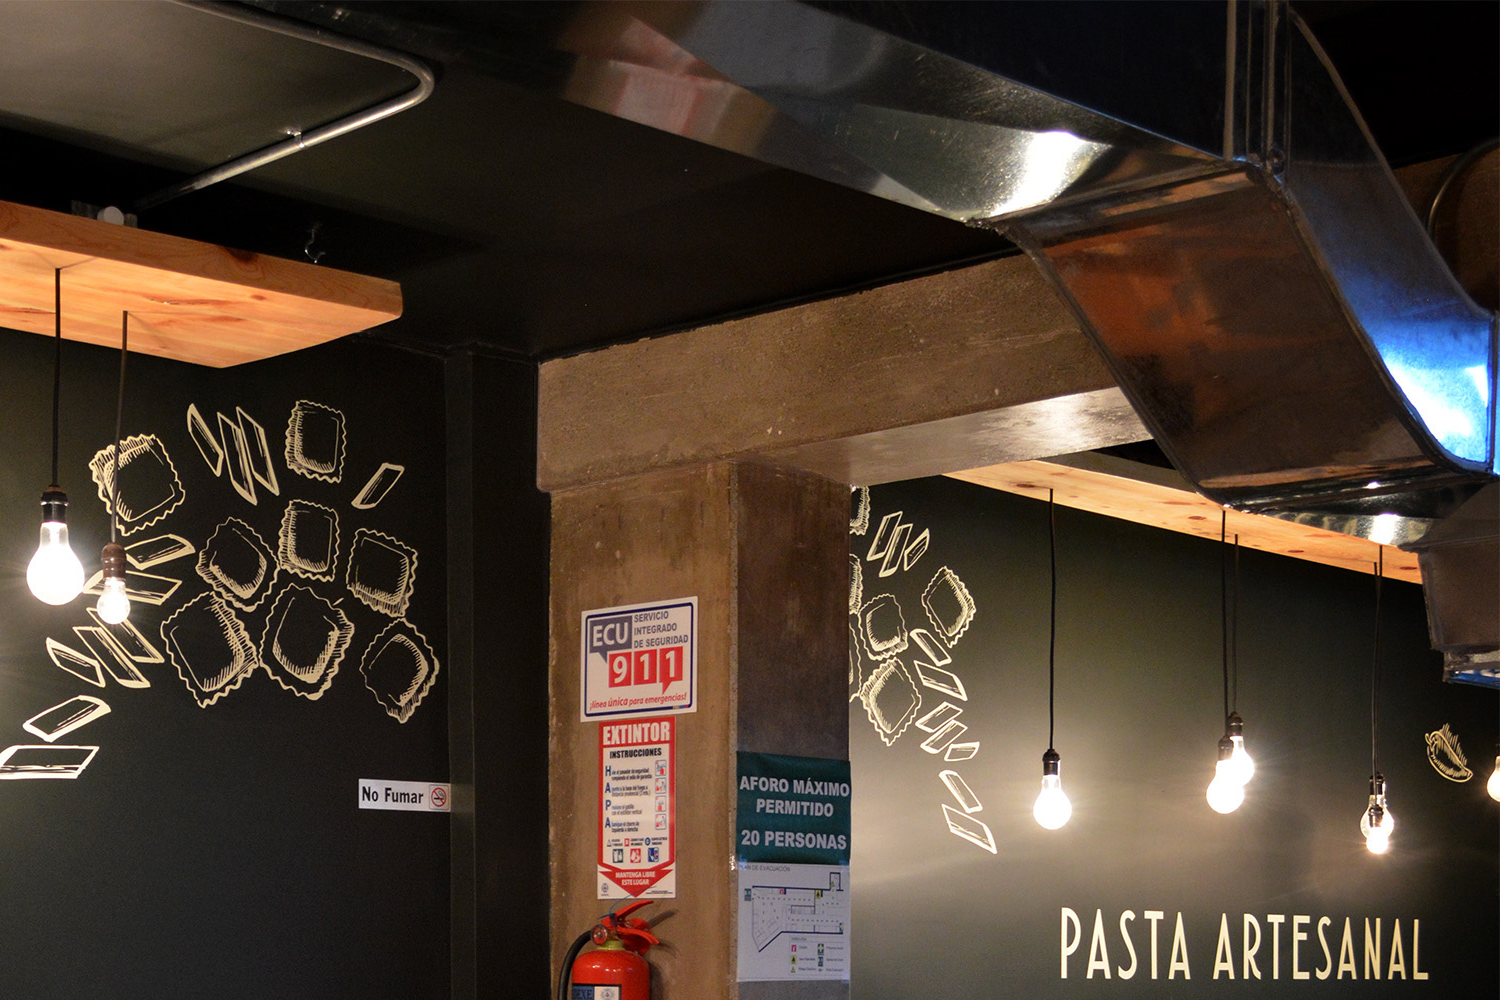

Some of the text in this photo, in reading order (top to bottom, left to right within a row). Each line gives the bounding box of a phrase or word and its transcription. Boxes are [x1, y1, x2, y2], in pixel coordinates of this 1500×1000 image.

[634, 611, 669, 623] SERVICIO
[592, 622, 629, 647] ECU
[634, 623, 677, 636] INTEGRADO
[634, 634, 689, 649] DE SEGURIDAD
[629, 698, 644, 707] para
[602, 721, 670, 745] EXTINTOR
[610, 748, 662, 759] INSTRUCCIONES
[362, 786, 424, 804] No Fumar
[739, 776, 850, 797] AFORO MÁXIMO
[756, 799, 834, 818] PERMITIDO
[741, 829, 847, 850] 20 PERSONAS
[1060, 907, 1429, 980] PASTA ARTESANAL
